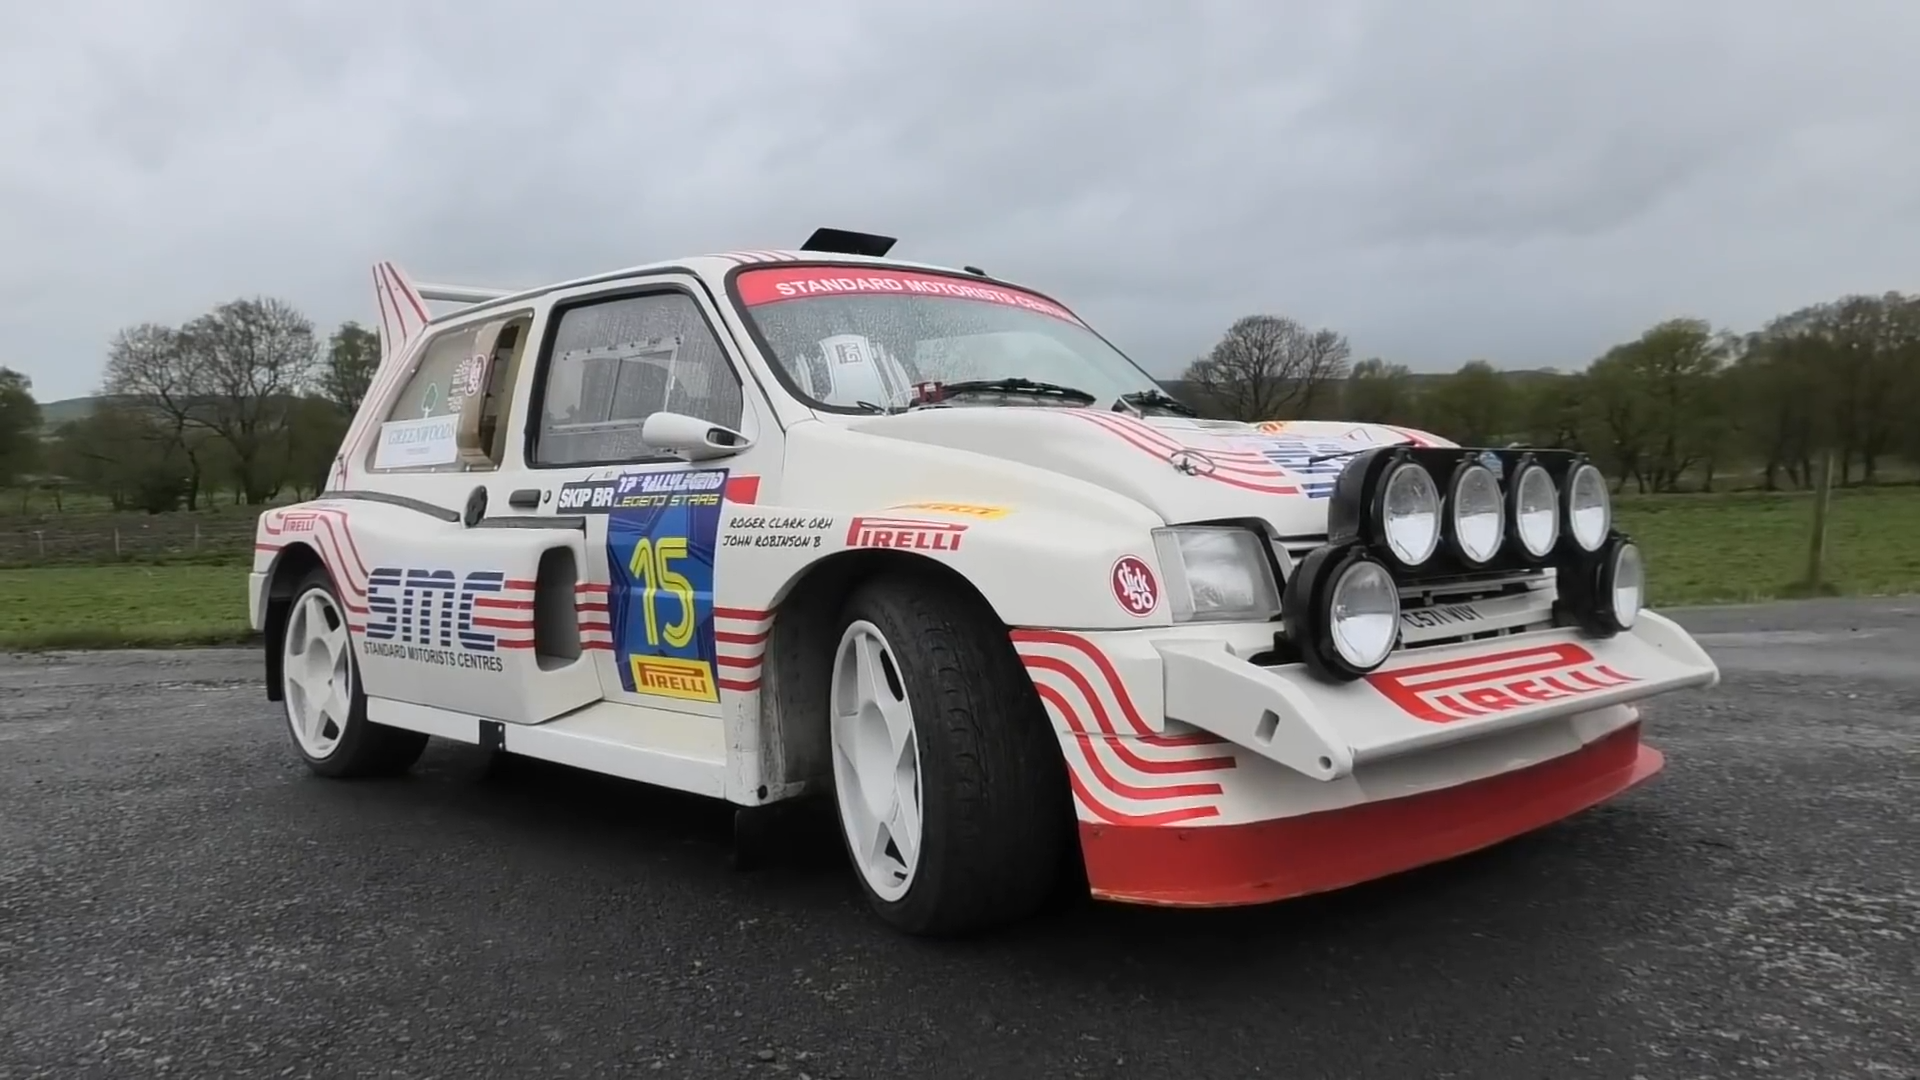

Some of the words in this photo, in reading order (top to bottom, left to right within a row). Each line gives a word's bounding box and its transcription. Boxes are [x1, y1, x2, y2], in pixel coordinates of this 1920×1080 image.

[776, 278, 903, 296] STANDARD
[903, 279, 1016, 304] MOTORISTS
[558, 488, 592, 509] SKIP
[613, 495, 667, 508] LEGEND
[669, 493, 720, 507] STARS
[282, 513, 318, 532] PIRELLI
[729, 517, 766, 529] ROGER
[768, 517, 806, 529] CLARK
[808, 518, 834, 529] ORH
[722, 535, 753, 547] JOHN
[754, 535, 811, 548] ROBINSON
[813, 536, 822, 548] B
[846, 517, 969, 551] PIRELLI
[629, 537, 695, 648] 15
[1130, 590, 1154, 610] 50
[1401, 609, 1453, 628] C571
[363, 641, 406, 658] STANDARD
[407, 647, 456, 666] MOTORISTS
[457, 653, 503, 672] CENTRES
[638, 661, 708, 694] PIRELLI
[1363, 642, 1644, 724] PIRELLI
